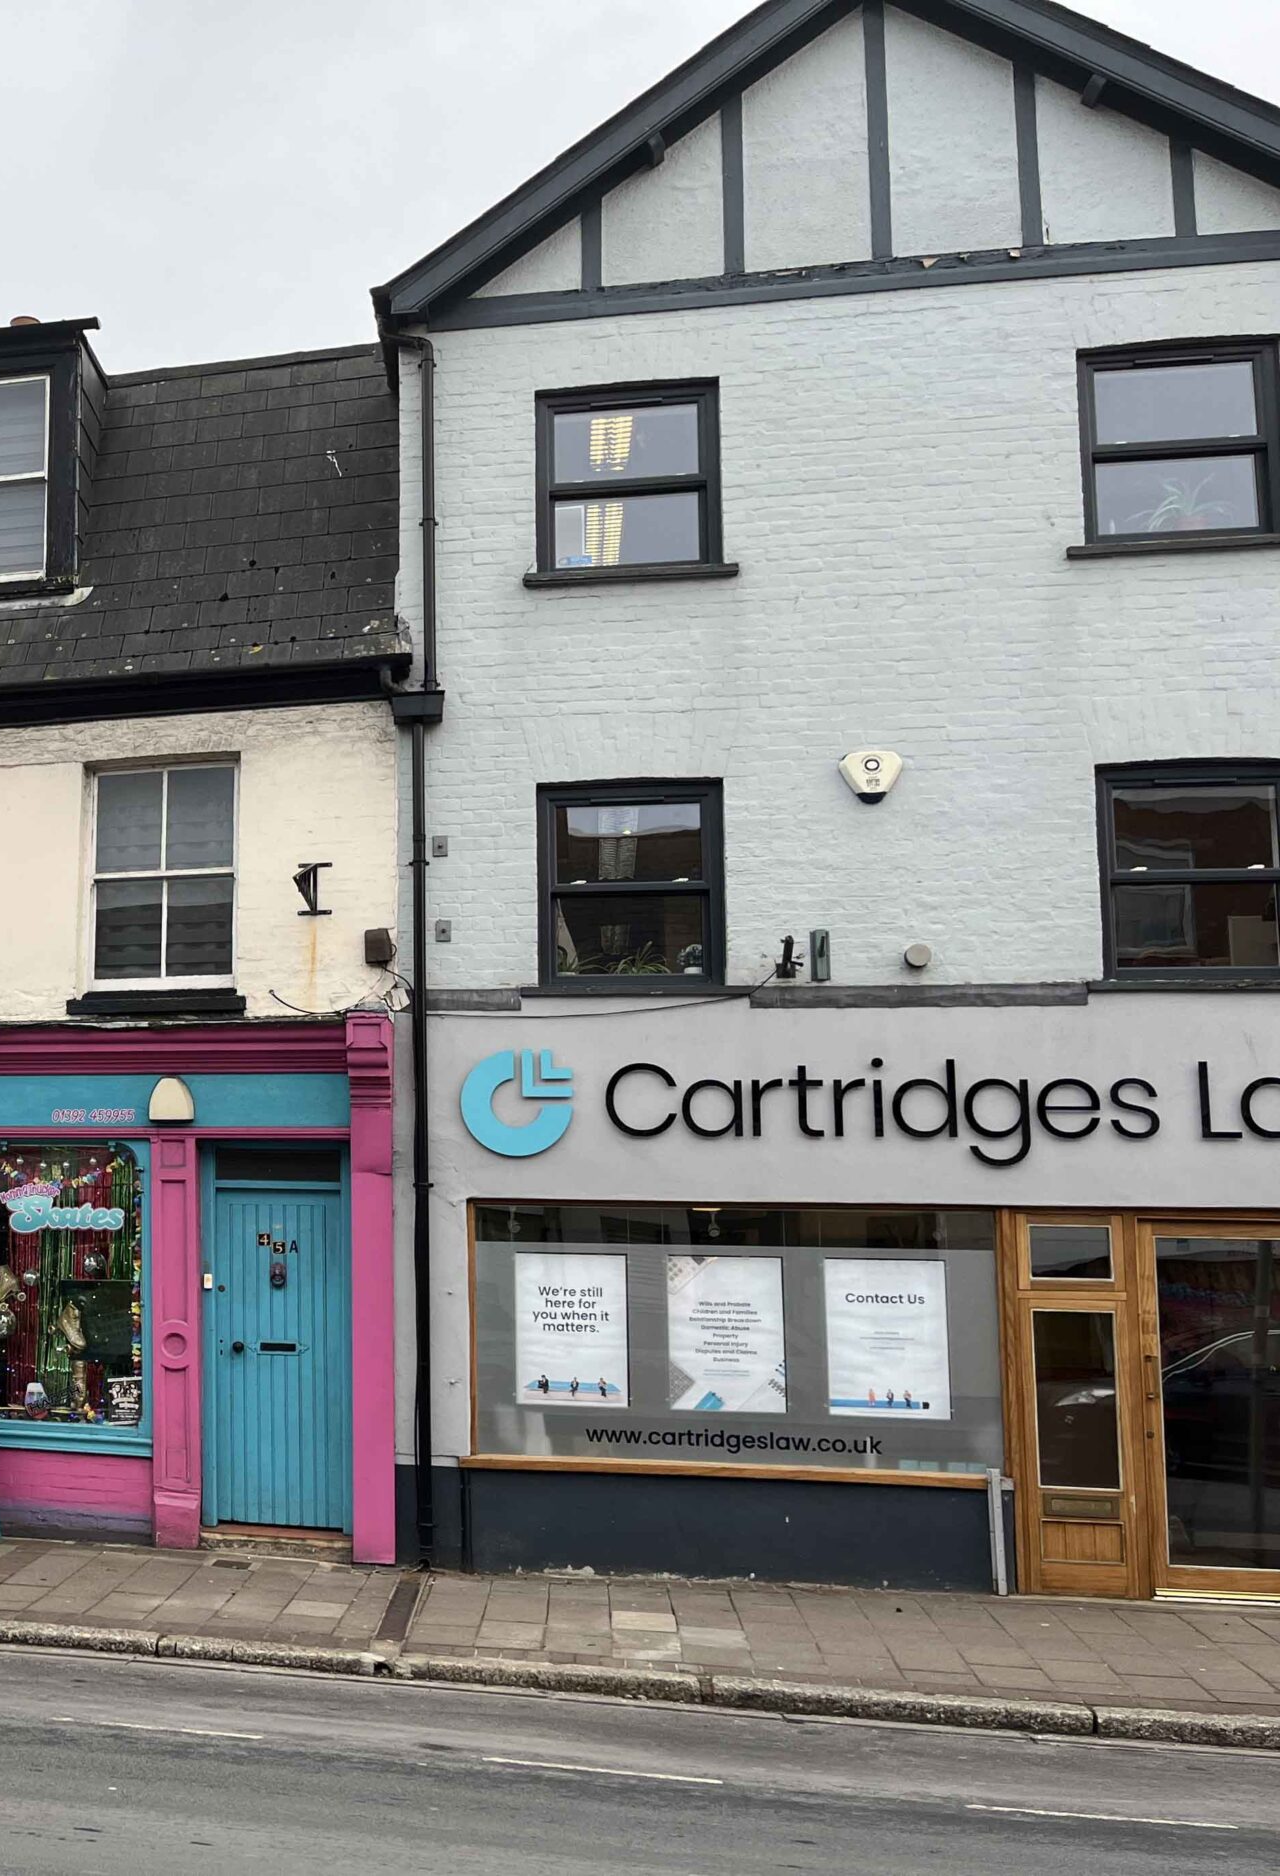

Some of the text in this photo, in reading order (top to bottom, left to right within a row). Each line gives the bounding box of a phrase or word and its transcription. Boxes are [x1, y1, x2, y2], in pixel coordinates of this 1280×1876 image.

[88, 1108, 136, 1124] 459955
[604, 1056, 1162, 1168] Cartridges
[6, 1194, 125, 1233] Skates
[537, 1286, 603, 1298] We're still
[845, 1292, 925, 1305] Contact Us
[545, 1298, 597, 1310] here for
[532, 1310, 610, 1323] you when it
[542, 1322, 600, 1334] matters.
[695, 1348, 721, 1356] Disputes
[585, 1427, 883, 1455] www.cartridgeslaw.co.uk
